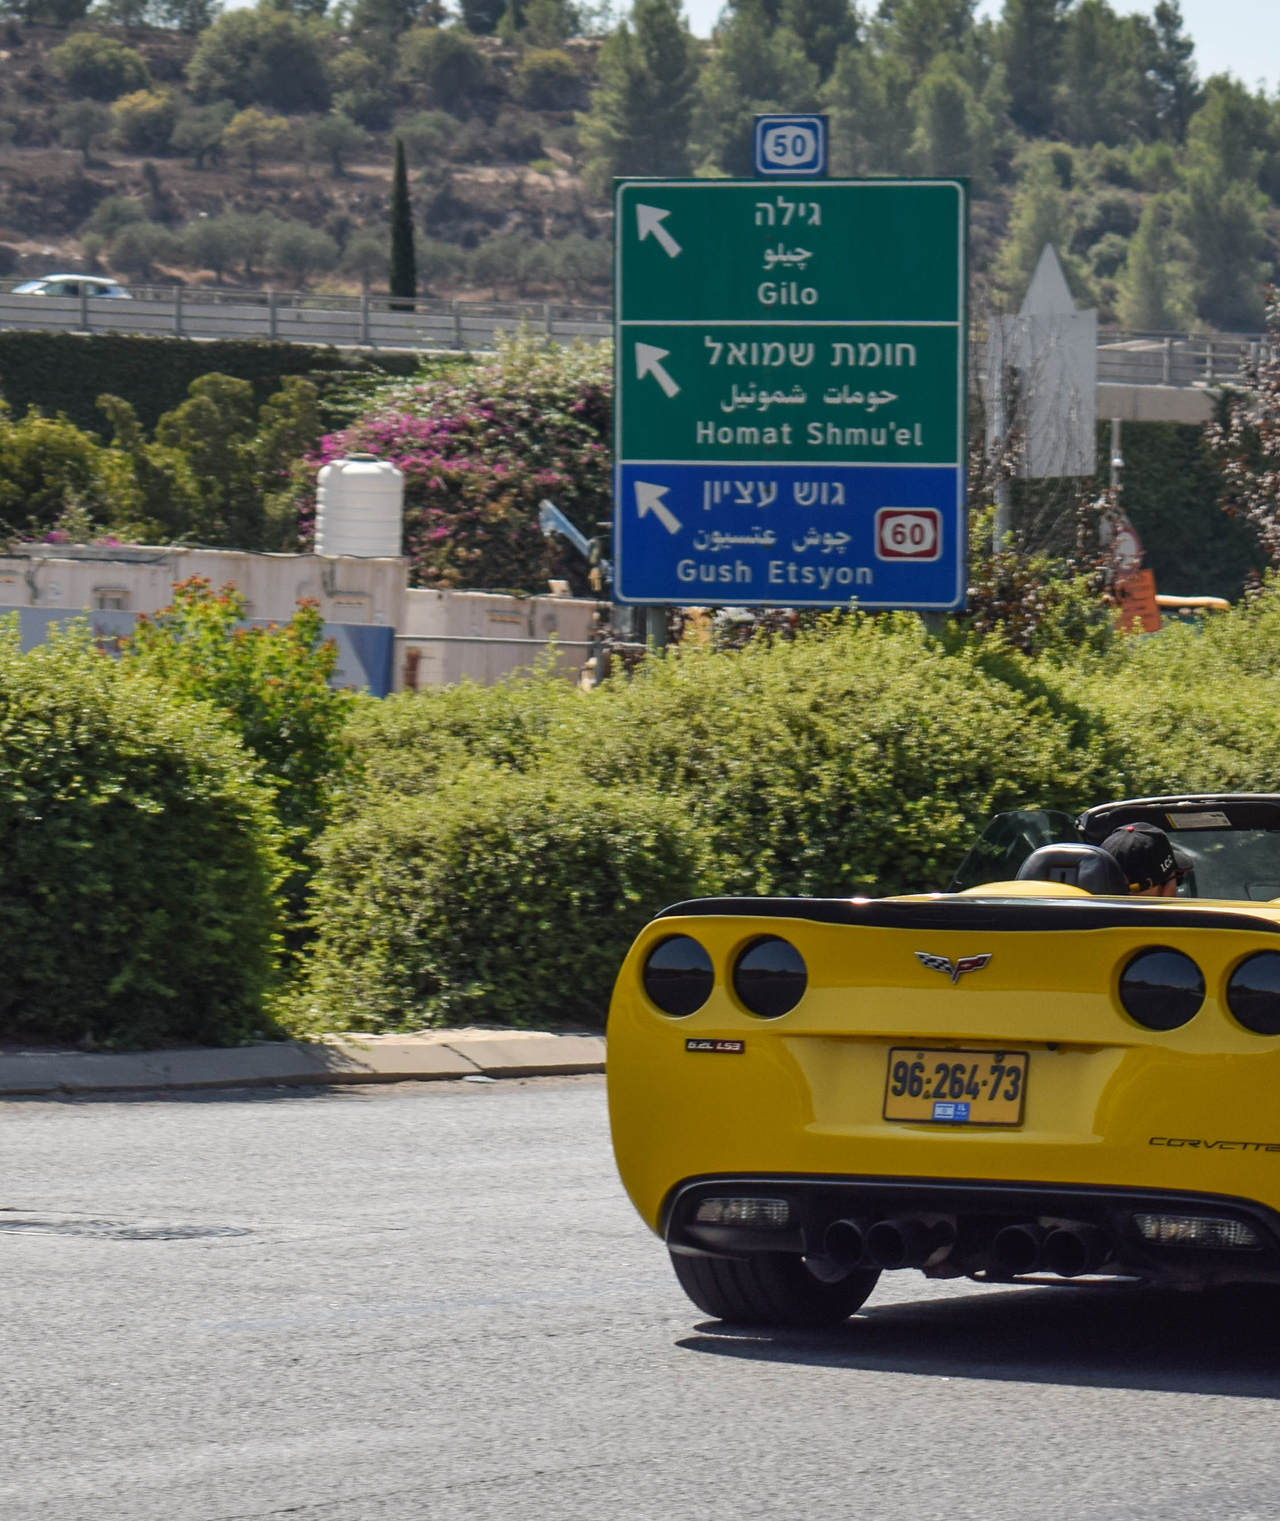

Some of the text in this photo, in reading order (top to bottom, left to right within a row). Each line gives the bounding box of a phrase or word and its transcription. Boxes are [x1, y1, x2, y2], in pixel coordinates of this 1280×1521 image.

[773, 134, 807, 157] 50
[755, 196, 822, 226] גילה
[757, 282, 819, 305] Gilo
[704, 335, 917, 367] חומת שמואל
[823, 385, 899, 412] حومات
[696, 421, 923, 446] Homat Shmu'el
[703, 480, 846, 511] גוש עציון
[891, 522, 926, 546] 60
[676, 559, 874, 590] Gush Etsyon
